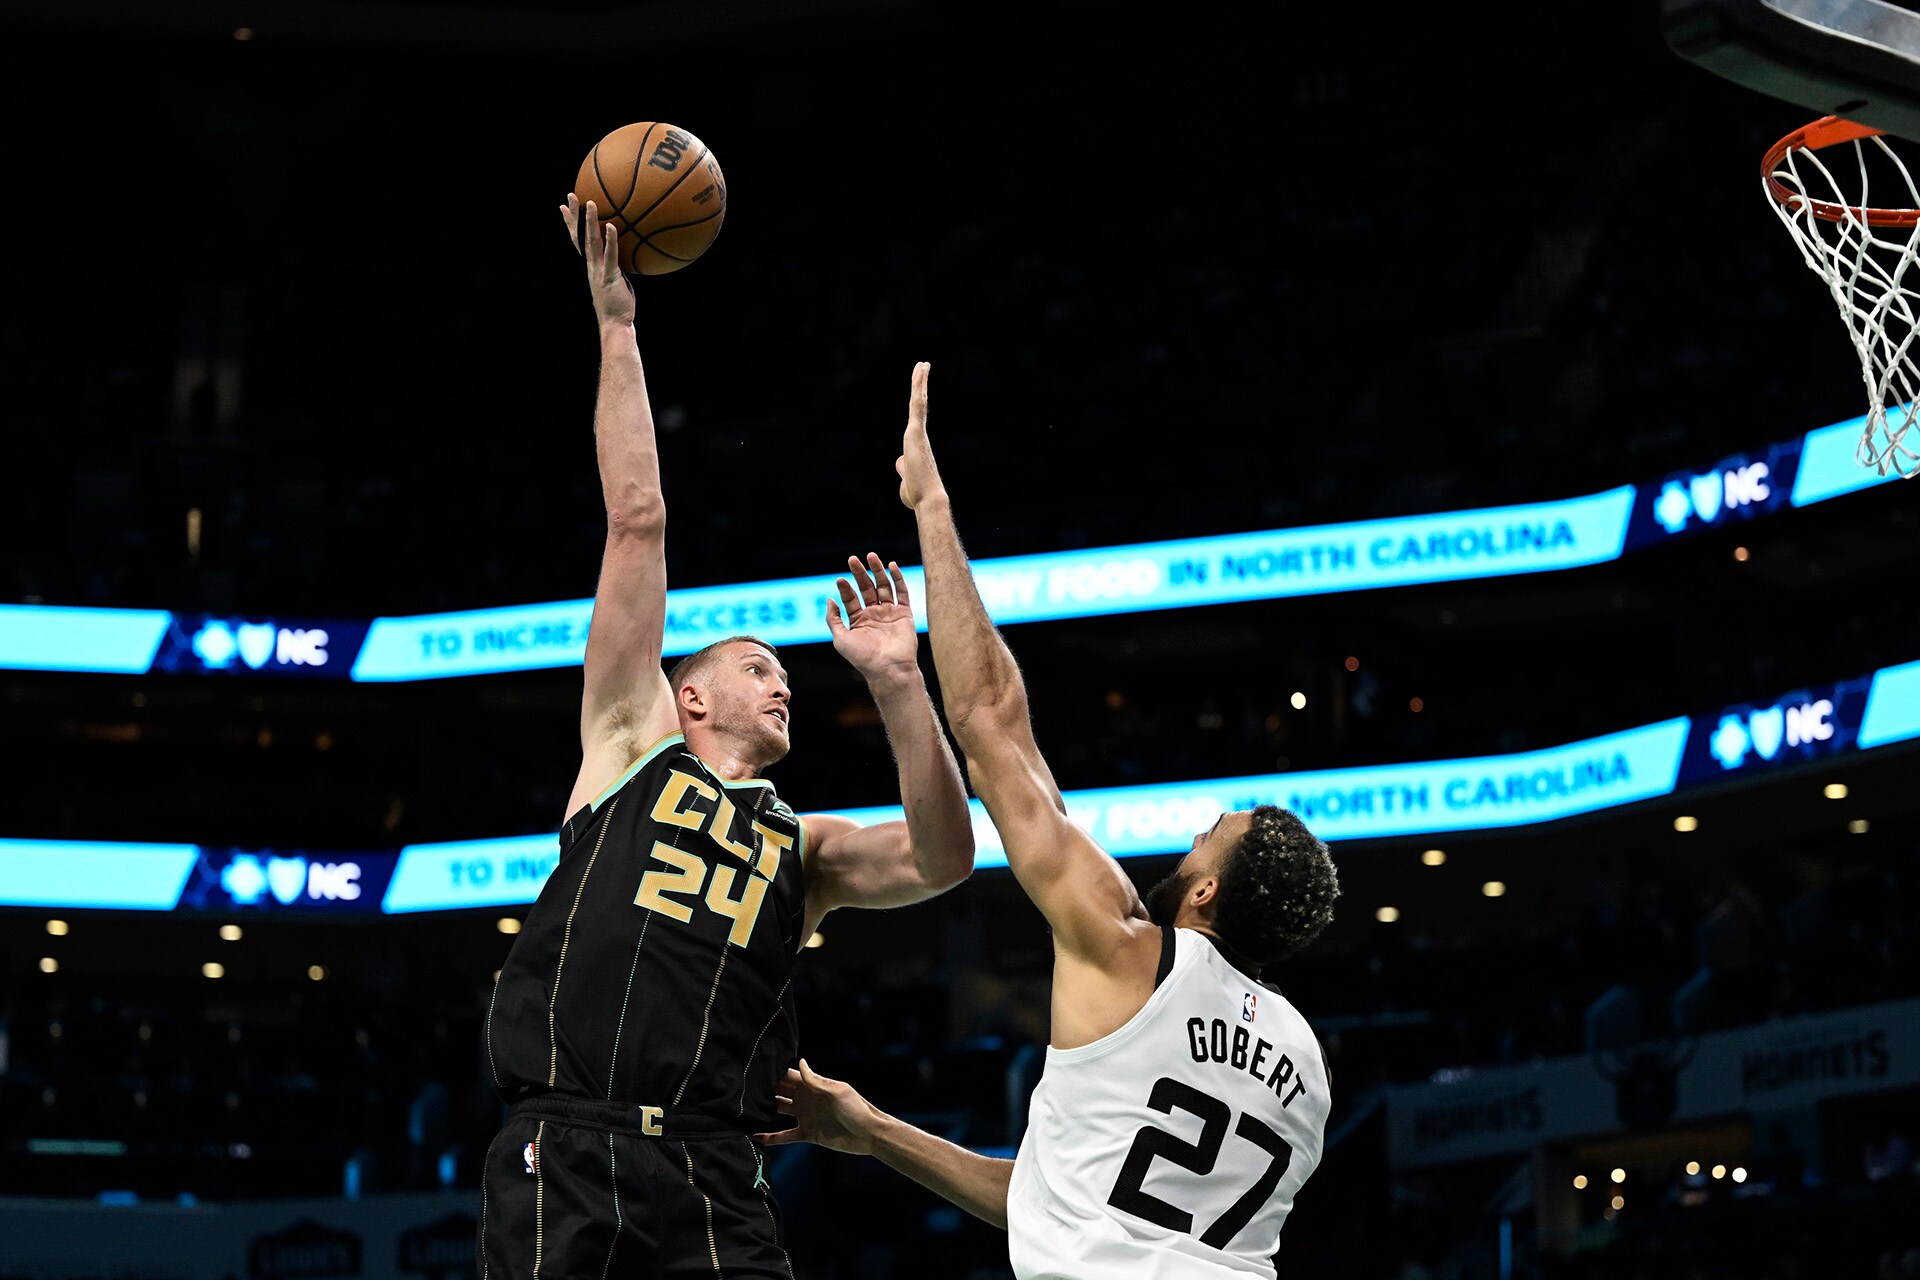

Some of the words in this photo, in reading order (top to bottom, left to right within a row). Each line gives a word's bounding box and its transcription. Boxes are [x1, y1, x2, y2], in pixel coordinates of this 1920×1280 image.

[1724, 461, 1770, 508] NC
[420, 630, 462, 658] TO
[474, 619, 590, 653] INCRE
[1047, 557, 1160, 605] FOOD
[1168, 558, 1209, 587] IN
[1220, 543, 1357, 580] NORTH
[1370, 520, 1575, 565] CAROLINA
[276, 628, 329, 666] NC
[1786, 699, 1834, 748] NC
[449, 857, 493, 887] TO
[1288, 783, 1428, 820] NORTH
[1443, 751, 1631, 806] CAROLINA
[650, 768, 794, 882] CLT
[307, 861, 361, 900] NC
[633, 840, 769, 948] 24
[1186, 1017, 1306, 1109] GOBERT
[639, 1105, 664, 1136] C
[1107, 1076, 1293, 1251] 27
